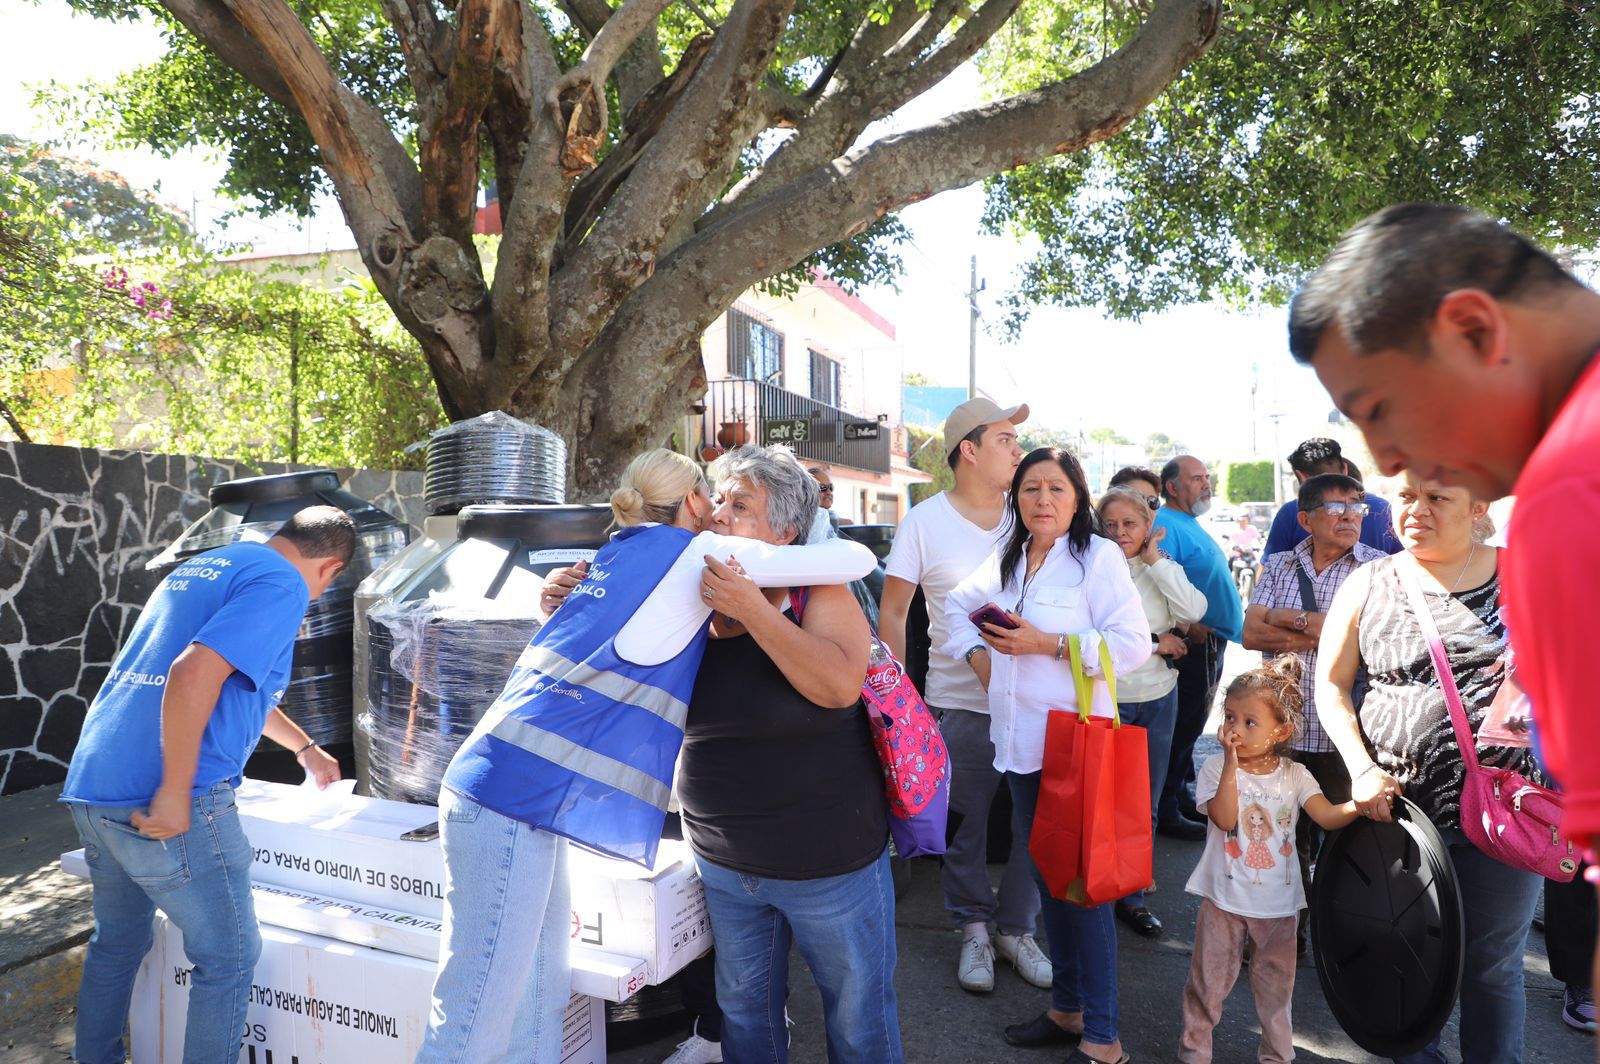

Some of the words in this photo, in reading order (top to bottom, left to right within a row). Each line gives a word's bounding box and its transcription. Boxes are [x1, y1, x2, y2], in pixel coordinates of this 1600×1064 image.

[570, 584, 606, 598] DILLO
[273, 851, 310, 872] PARA
[314, 859, 362, 883] VIDRIO
[366, 869, 386, 888] DE
[390, 874, 443, 899] TUBOS
[275, 988, 302, 1014] PARA
[303, 996, 333, 1022] AGUA
[336, 1004, 350, 1026] DE
[353, 1008, 399, 1038] TANQUE
